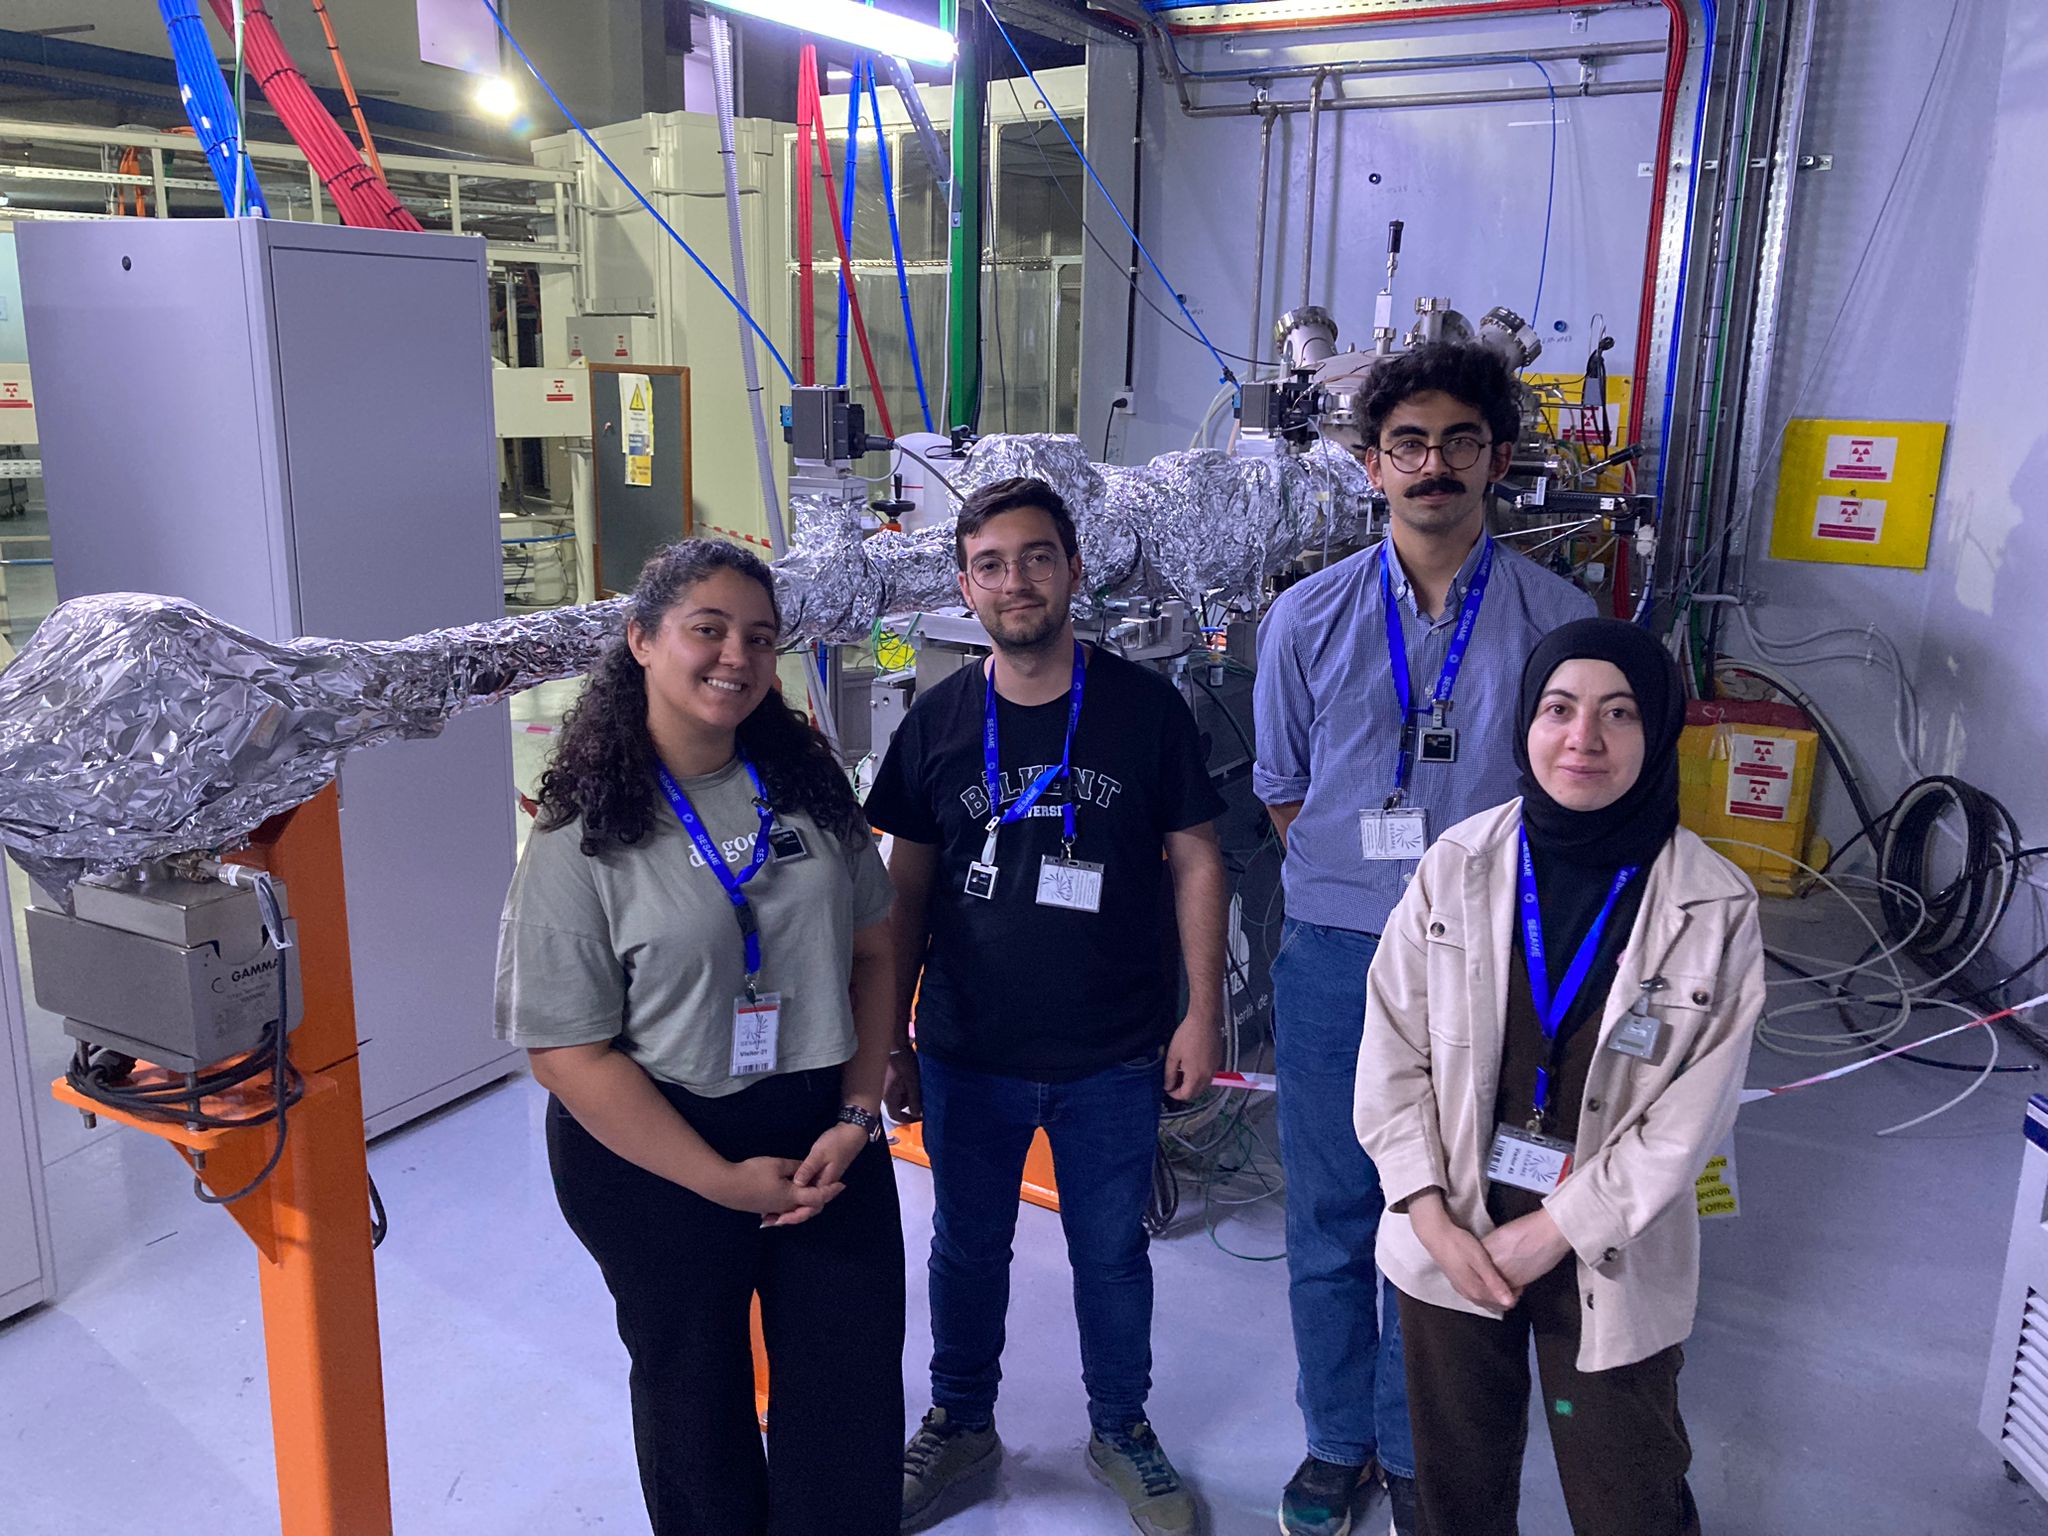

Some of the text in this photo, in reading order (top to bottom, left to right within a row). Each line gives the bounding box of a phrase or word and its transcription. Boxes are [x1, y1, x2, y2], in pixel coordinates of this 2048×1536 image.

[1456, 608, 1474, 642] SESAME
[986, 718, 996, 749] SESAME
[1014, 786, 1039, 815] SESAME
[696, 833, 721, 867] SESAME
[721, 832, 758, 863] goo
[1522, 840, 1533, 877] SESAME
[1527, 918, 1541, 958] SESAME
